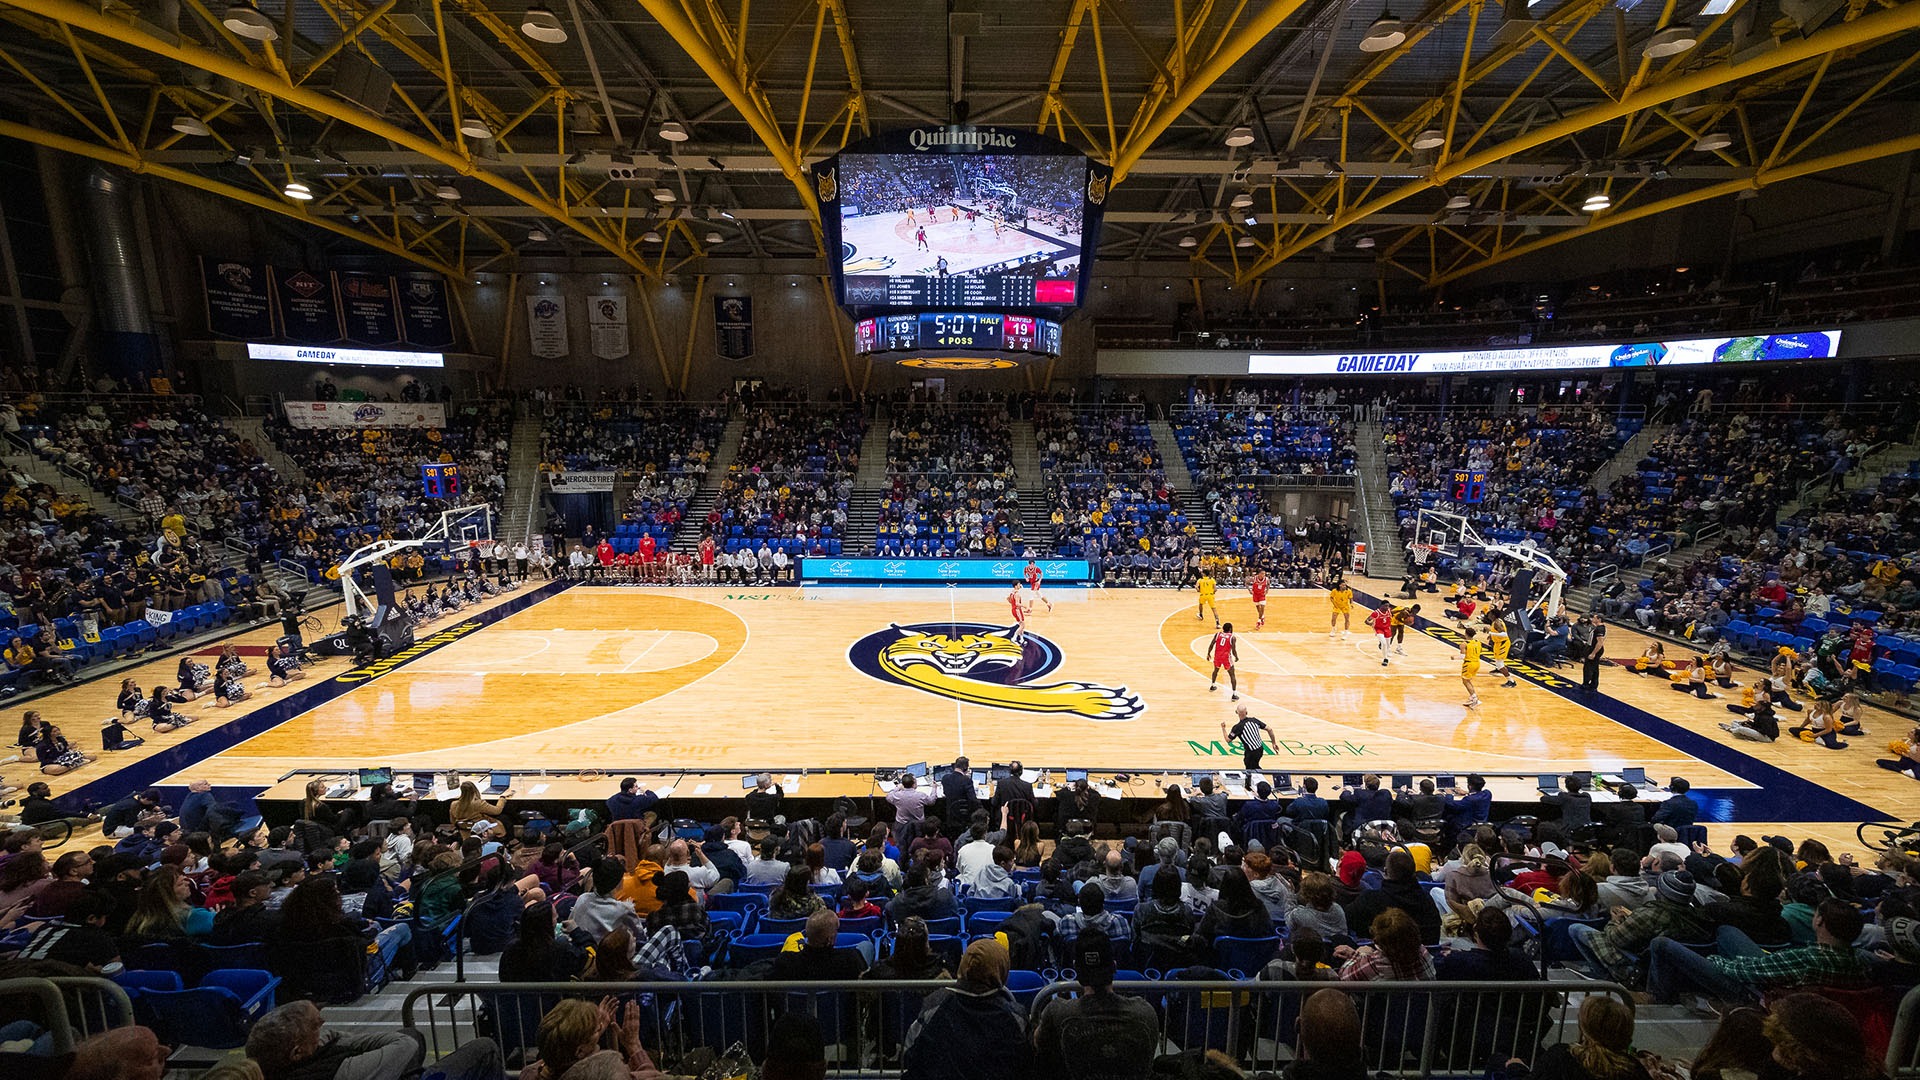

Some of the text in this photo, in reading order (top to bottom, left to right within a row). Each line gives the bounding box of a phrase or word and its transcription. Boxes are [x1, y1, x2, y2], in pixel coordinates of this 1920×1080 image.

[909, 126, 1017, 151] Quinnipiac
[935, 314, 977, 334] 5:07
[1008, 316, 1032, 324] FAIRFIELD
[862, 326, 870, 338] 19
[894, 322, 909, 334] 19
[988, 326, 994, 336] 1
[1013, 322, 1028, 335] 19
[890, 340, 910, 349] 3 4
[948, 337, 973, 345] POSS
[1008, 341, 1028, 350] 3 4
[296, 350, 336, 360] GAMEDAY
[1462, 349, 1568, 361] EXPANDED ADIDAS OFFERINGS
[1336, 354, 1420, 372] GAMEDAY
[1448, 362, 1483, 370] AVAILABLE
[1485, 361, 1494, 369] AT
[1496, 360, 1508, 369] THE
[1509, 359, 1554, 369] QUINNIPIAC
[1556, 357, 1601, 367] BOOKSTORE
[354, 408, 384, 422] MAAC
[444, 467, 457, 476] 5:07
[1455, 473, 1469, 482] 5:07
[450, 478, 456, 493] 2
[1456, 484, 1466, 499] 2
[148, 612, 167, 622] KING
[1220, 638, 1226, 646] 0
[336, 622, 482, 682] Quinnipiac
[1280, 740, 1379, 756] Bank
